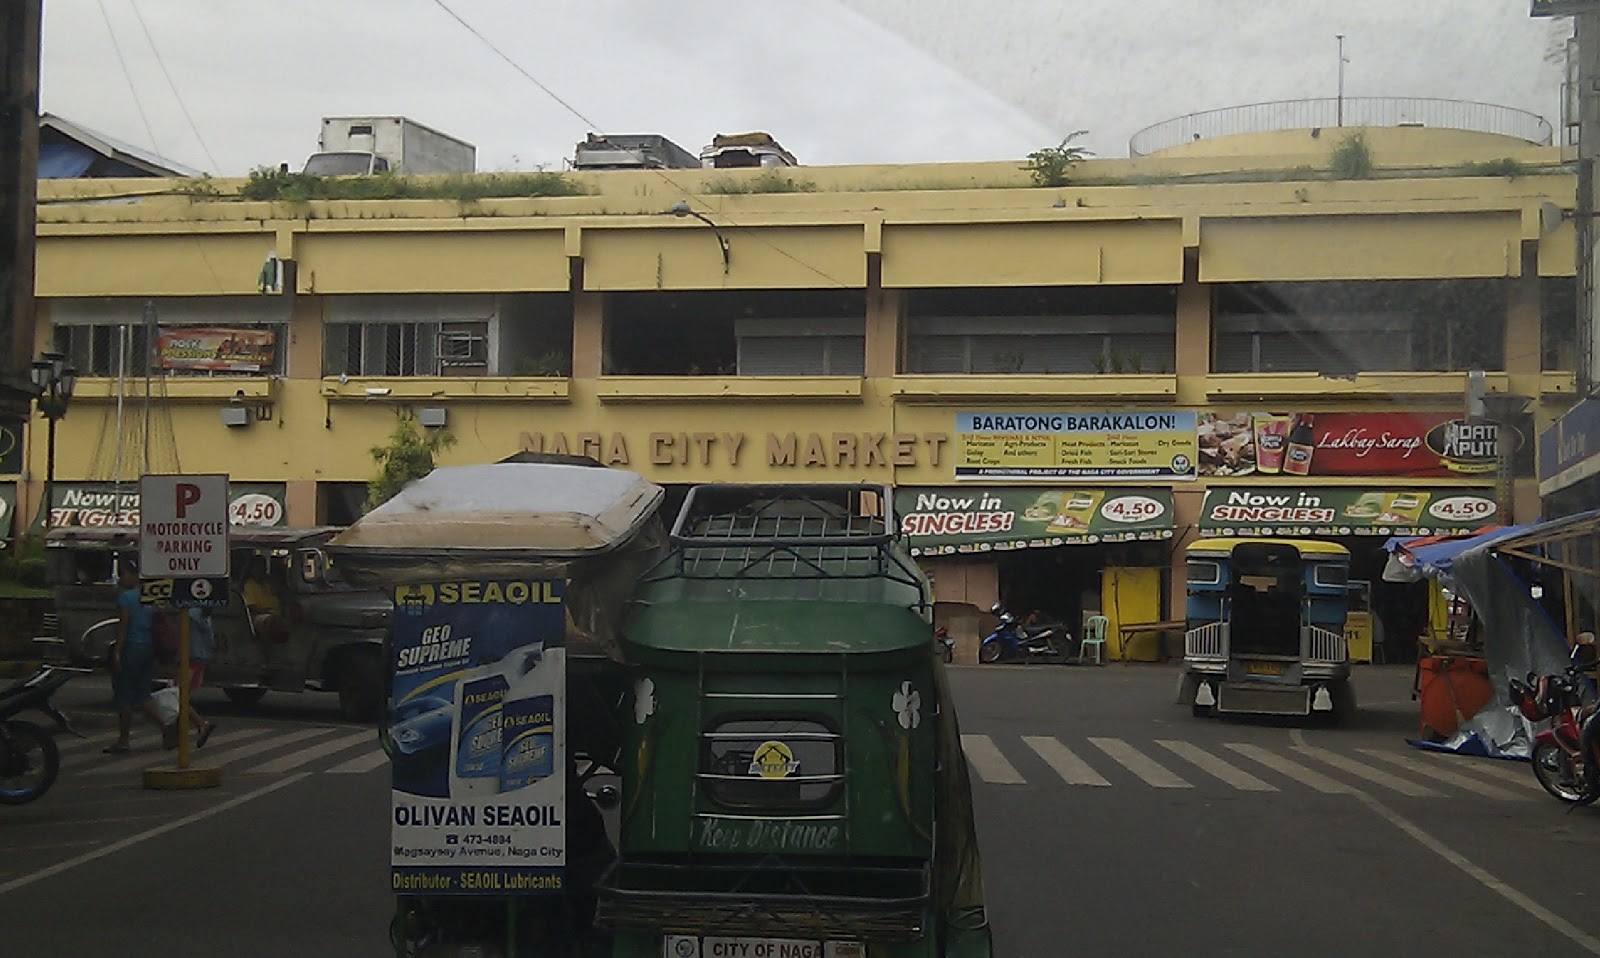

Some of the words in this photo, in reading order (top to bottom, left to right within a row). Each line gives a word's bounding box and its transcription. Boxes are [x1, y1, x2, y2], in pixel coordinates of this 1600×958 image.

[973, 416, 1062, 430] BARATONG
[1067, 415, 1175, 430] BARAKALON!
[519, 431, 629, 465] NAGA
[649, 432, 746, 466] CITY
[769, 432, 947, 466] MARKET
[1317, 428, 1375, 457] Lakbay
[1376, 432, 1423, 458] Sarap
[62, 489, 116, 506] Now
[175, 483, 201, 519] P
[916, 493, 974, 510] Now
[980, 492, 1002, 510] in
[1227, 492, 1290, 506] Now
[1298, 492, 1320, 507] in
[1211, 505, 1335, 522] SINGLES!
[146, 523, 223, 536] MOTORCYCLE
[903, 511, 1014, 535] SINGLES!
[156, 540, 213, 553] PARKING
[169, 557, 200, 571] ONLY
[421, 624, 452, 645] GEO
[398, 637, 472, 667] SUPREME
[394, 805, 475, 826] OLIVAN
[483, 805, 561, 826] SEAOIL
[508, 846, 537, 857] Naga
[540, 846, 562, 857] City
[393, 873, 451, 889] Distributor
[460, 873, 500, 889] SEAOIL
[504, 873, 562, 889] Lubricants
[713, 943, 749, 956] CITY
[755, 944, 775, 958] OF
